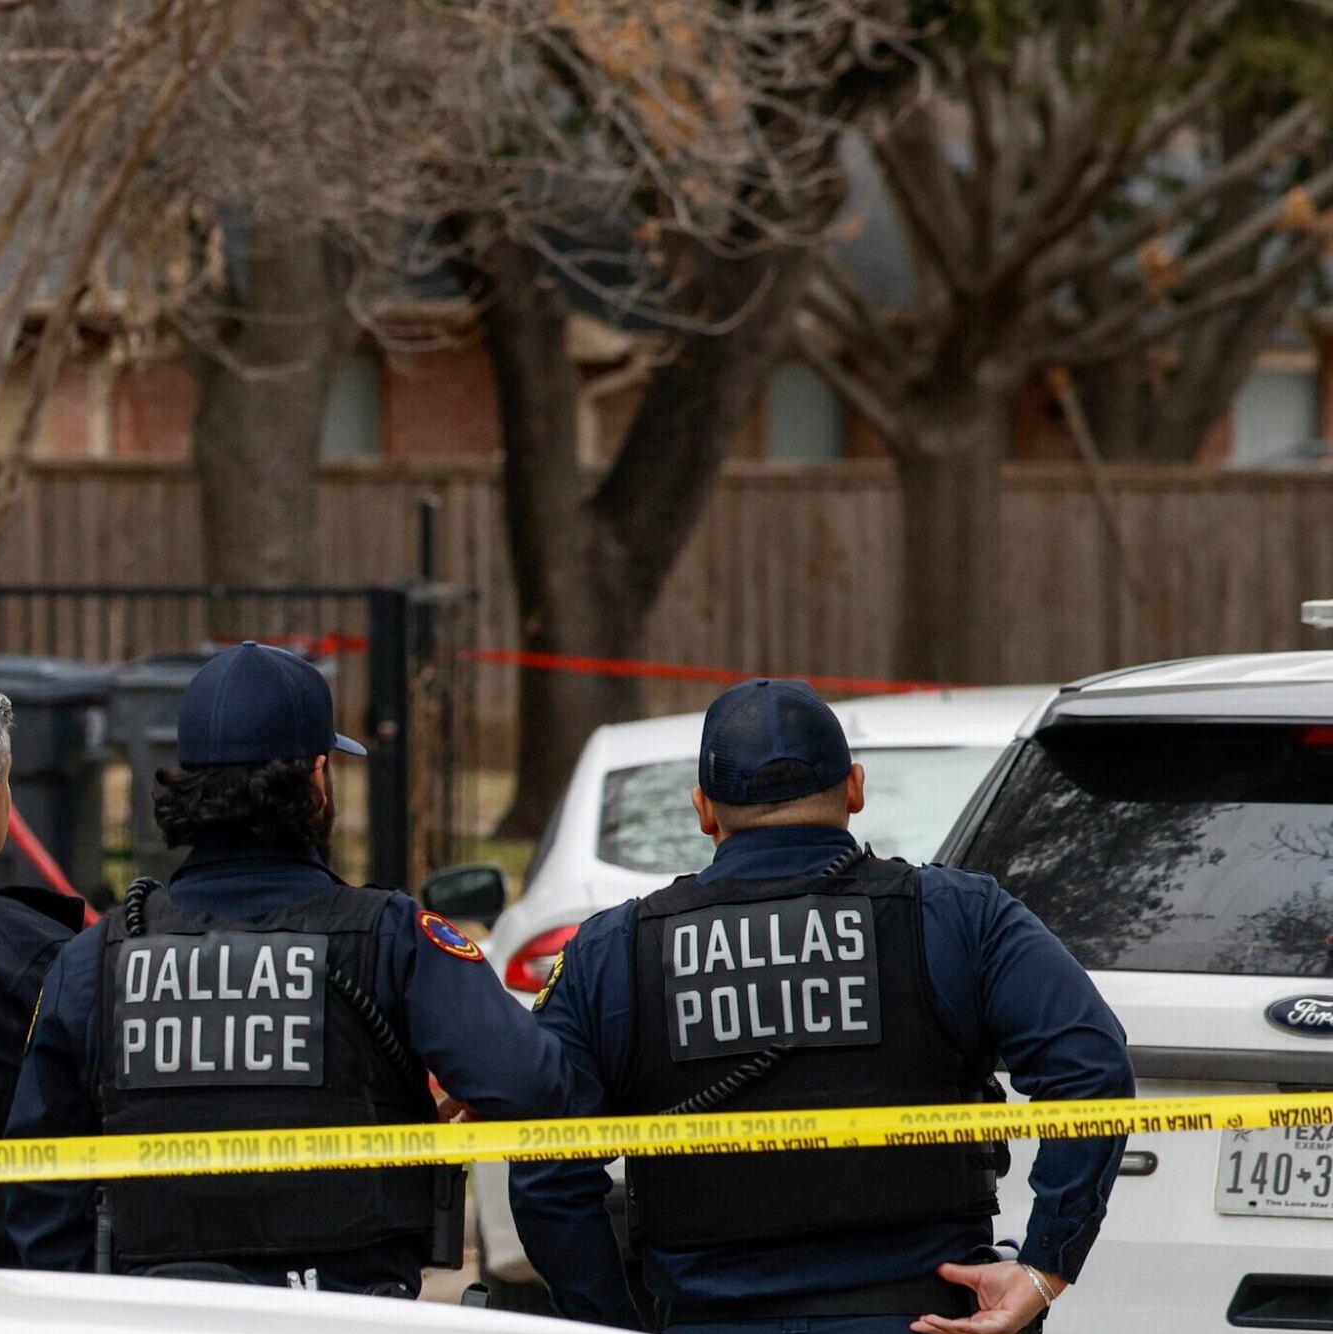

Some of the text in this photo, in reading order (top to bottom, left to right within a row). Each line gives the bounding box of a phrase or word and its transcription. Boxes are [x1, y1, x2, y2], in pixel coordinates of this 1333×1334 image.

[673, 909, 865, 977] DALLAS
[126, 945, 315, 1003] DALLAS
[675, 976, 868, 1046] POLICE
[1287, 998, 1333, 1026] For
[122, 1015, 311, 1075] POLICE
[1140, 1117, 1161, 1133] DE
[1167, 1113, 1213, 1131] LINEA
